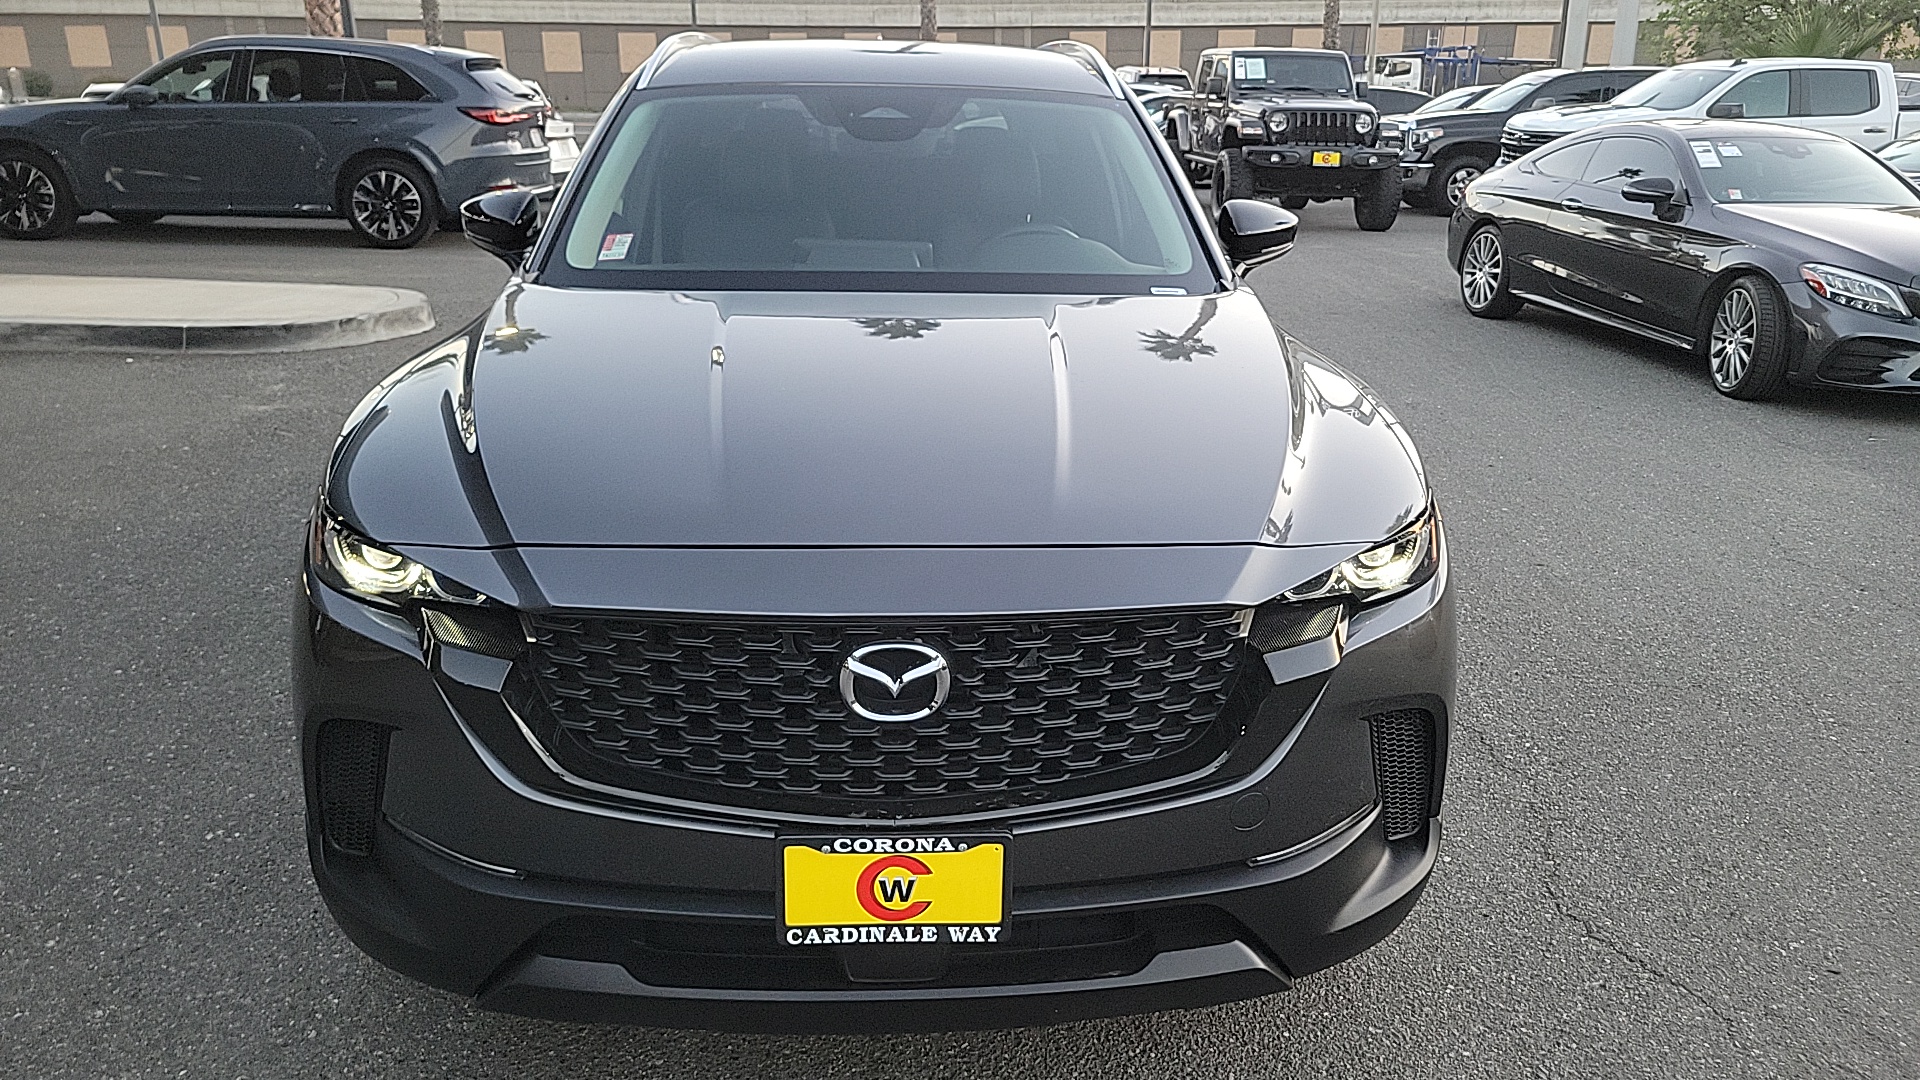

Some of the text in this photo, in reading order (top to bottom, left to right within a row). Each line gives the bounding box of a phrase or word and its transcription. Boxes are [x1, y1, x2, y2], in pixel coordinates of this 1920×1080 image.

[833, 837, 955, 853] CORONA
[878, 876, 918, 903] W
[786, 926, 1002, 945] CARDINALE WAY
